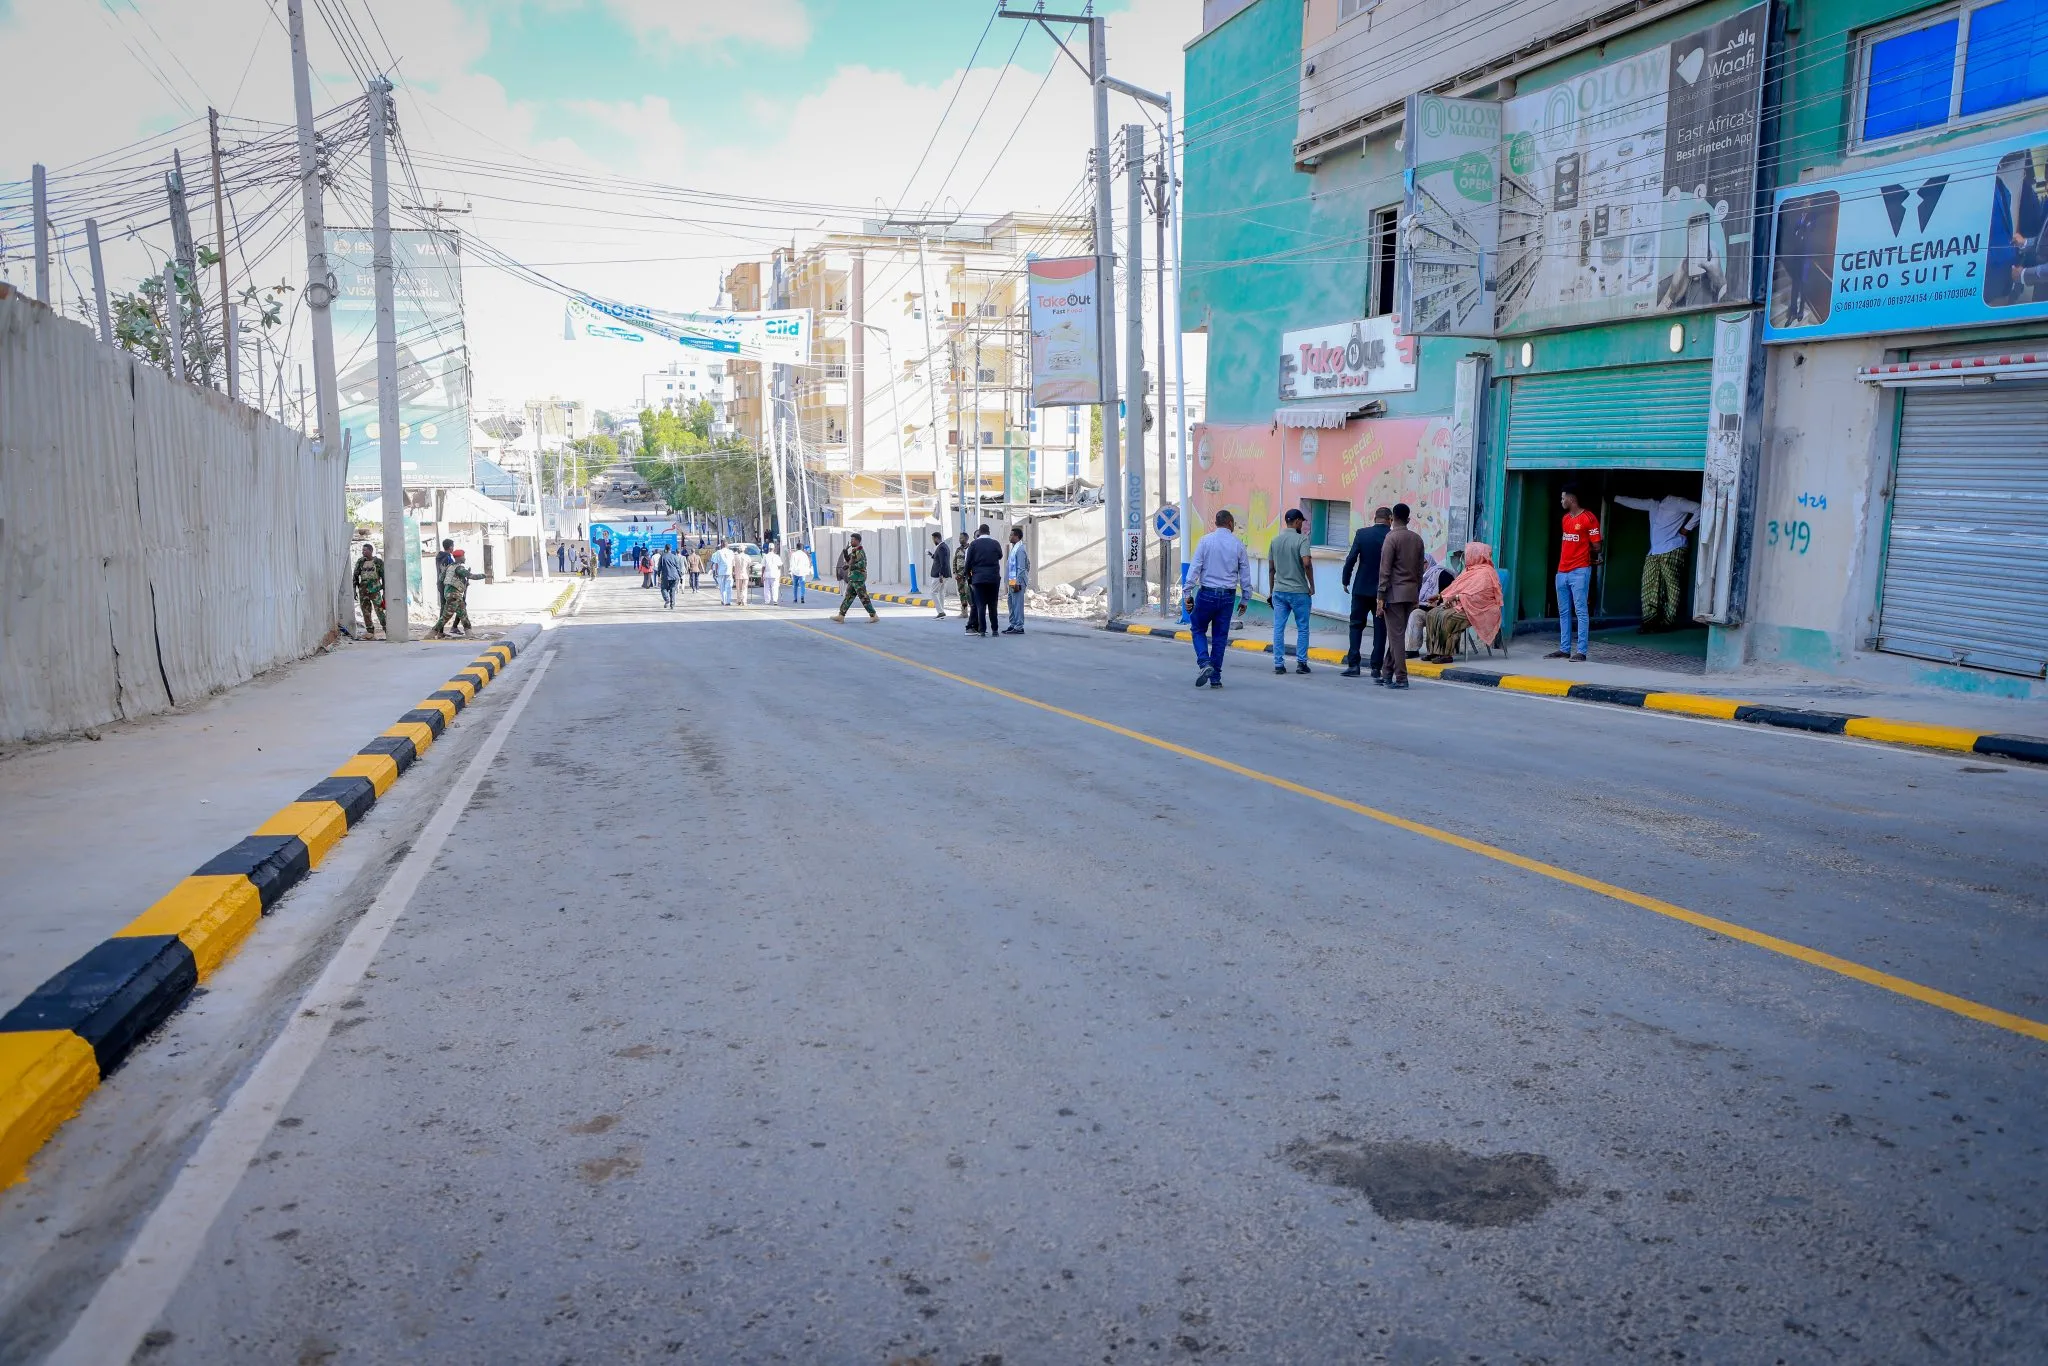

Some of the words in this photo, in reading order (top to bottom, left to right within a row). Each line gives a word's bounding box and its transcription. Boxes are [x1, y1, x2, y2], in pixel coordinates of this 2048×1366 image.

[1708, 48, 1754, 79] Waafi
[1577, 51, 1666, 112] OLOW
[1447, 104, 1500, 126] OLOW
[1677, 124, 1704, 144] East
[1707, 108, 1754, 135] Africa's
[1449, 123, 1497, 139] MARKET
[1676, 147, 1696, 161] Best
[1698, 137, 1732, 154] Fintech
[1734, 133, 1753, 146] App
[1460, 177, 1491, 190] OPEN
[1463, 162, 1489, 176] 24/7
[1841, 233, 1981, 271] GENTLEMAN
[1840, 273, 1889, 293] KIRO
[1901, 264, 1953, 286] SUIT
[1965, 261, 1977, 278] 2
[765, 319, 799, 336] Ciid
[1313, 375, 1338, 389] Fast
[1339, 371, 1369, 387] Food
[1342, 427, 1375, 465] Special
[1768, 520, 1811, 554] 349
